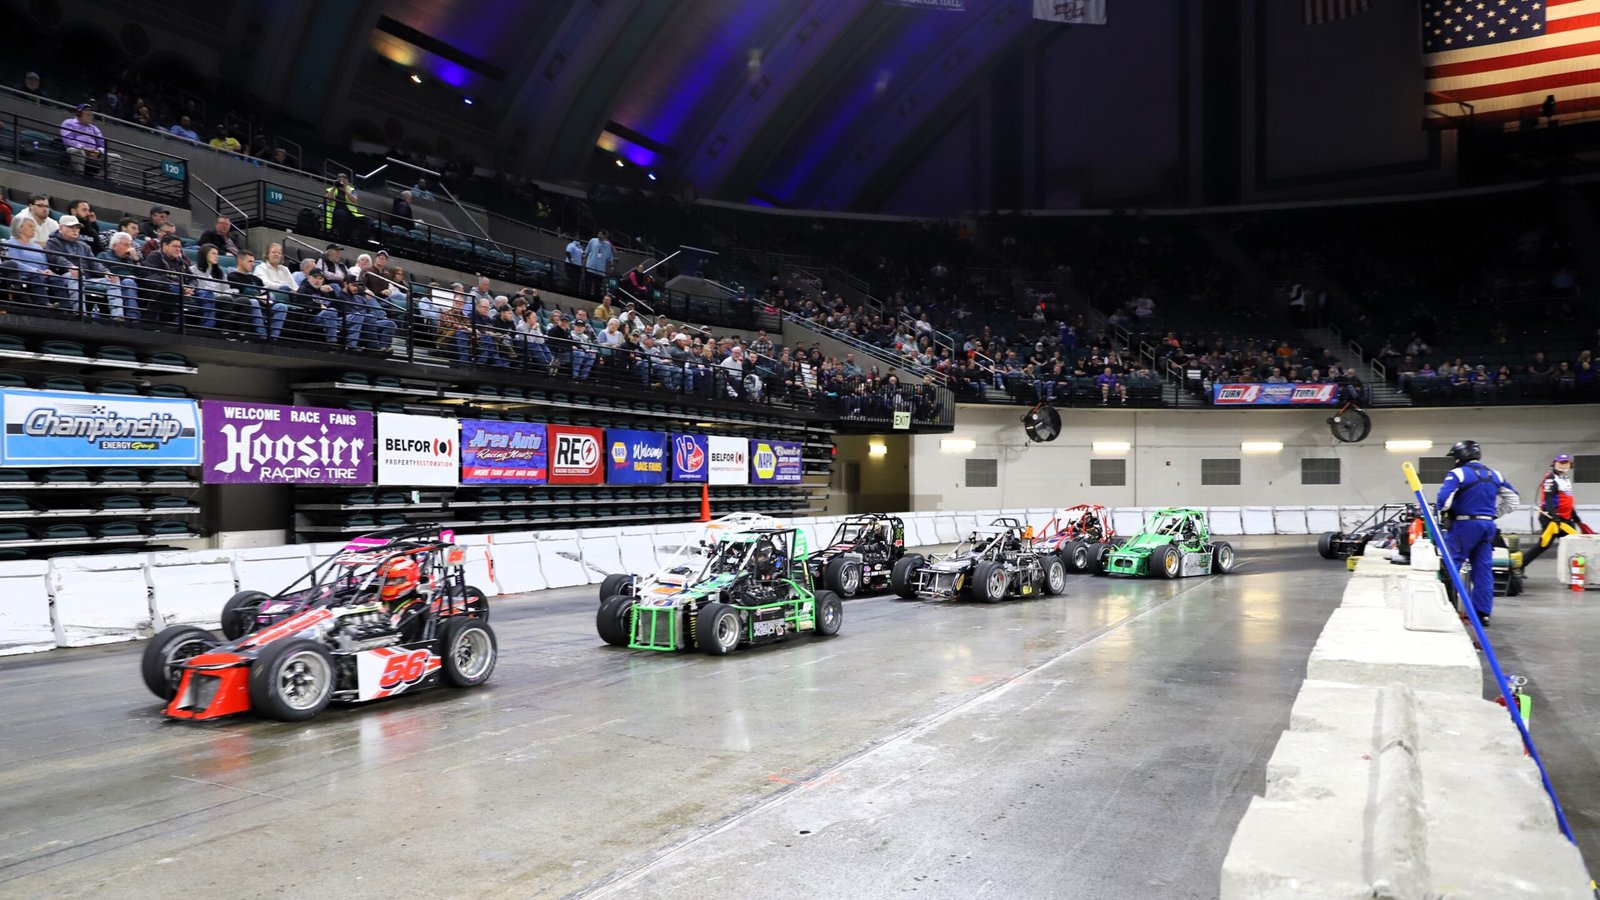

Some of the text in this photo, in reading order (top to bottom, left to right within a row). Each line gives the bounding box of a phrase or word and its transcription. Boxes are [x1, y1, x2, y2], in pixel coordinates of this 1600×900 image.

[165, 163, 180, 175] 120
[271, 191, 283, 201] 119
[1221, 389, 1243, 399] TURN
[1243, 386, 1260, 402] 4
[1295, 389, 1317, 399] TURN
[1317, 385, 1335, 402] 4
[224, 406, 357, 426] WELCOME RACE FANS
[895, 415, 909, 426] EXIT
[24, 407, 182, 443] Championship
[102, 441, 131, 449] ENERGY
[213, 421, 364, 474] Hoosier
[385, 438, 431, 452] BELFOR
[469, 429, 543, 450] Area Auto
[711, 452, 735, 462] BELFOR
[758, 452, 773, 468] NAPA
[260, 466, 358, 480] RACING TIRE
[379, 650, 429, 689] 56
